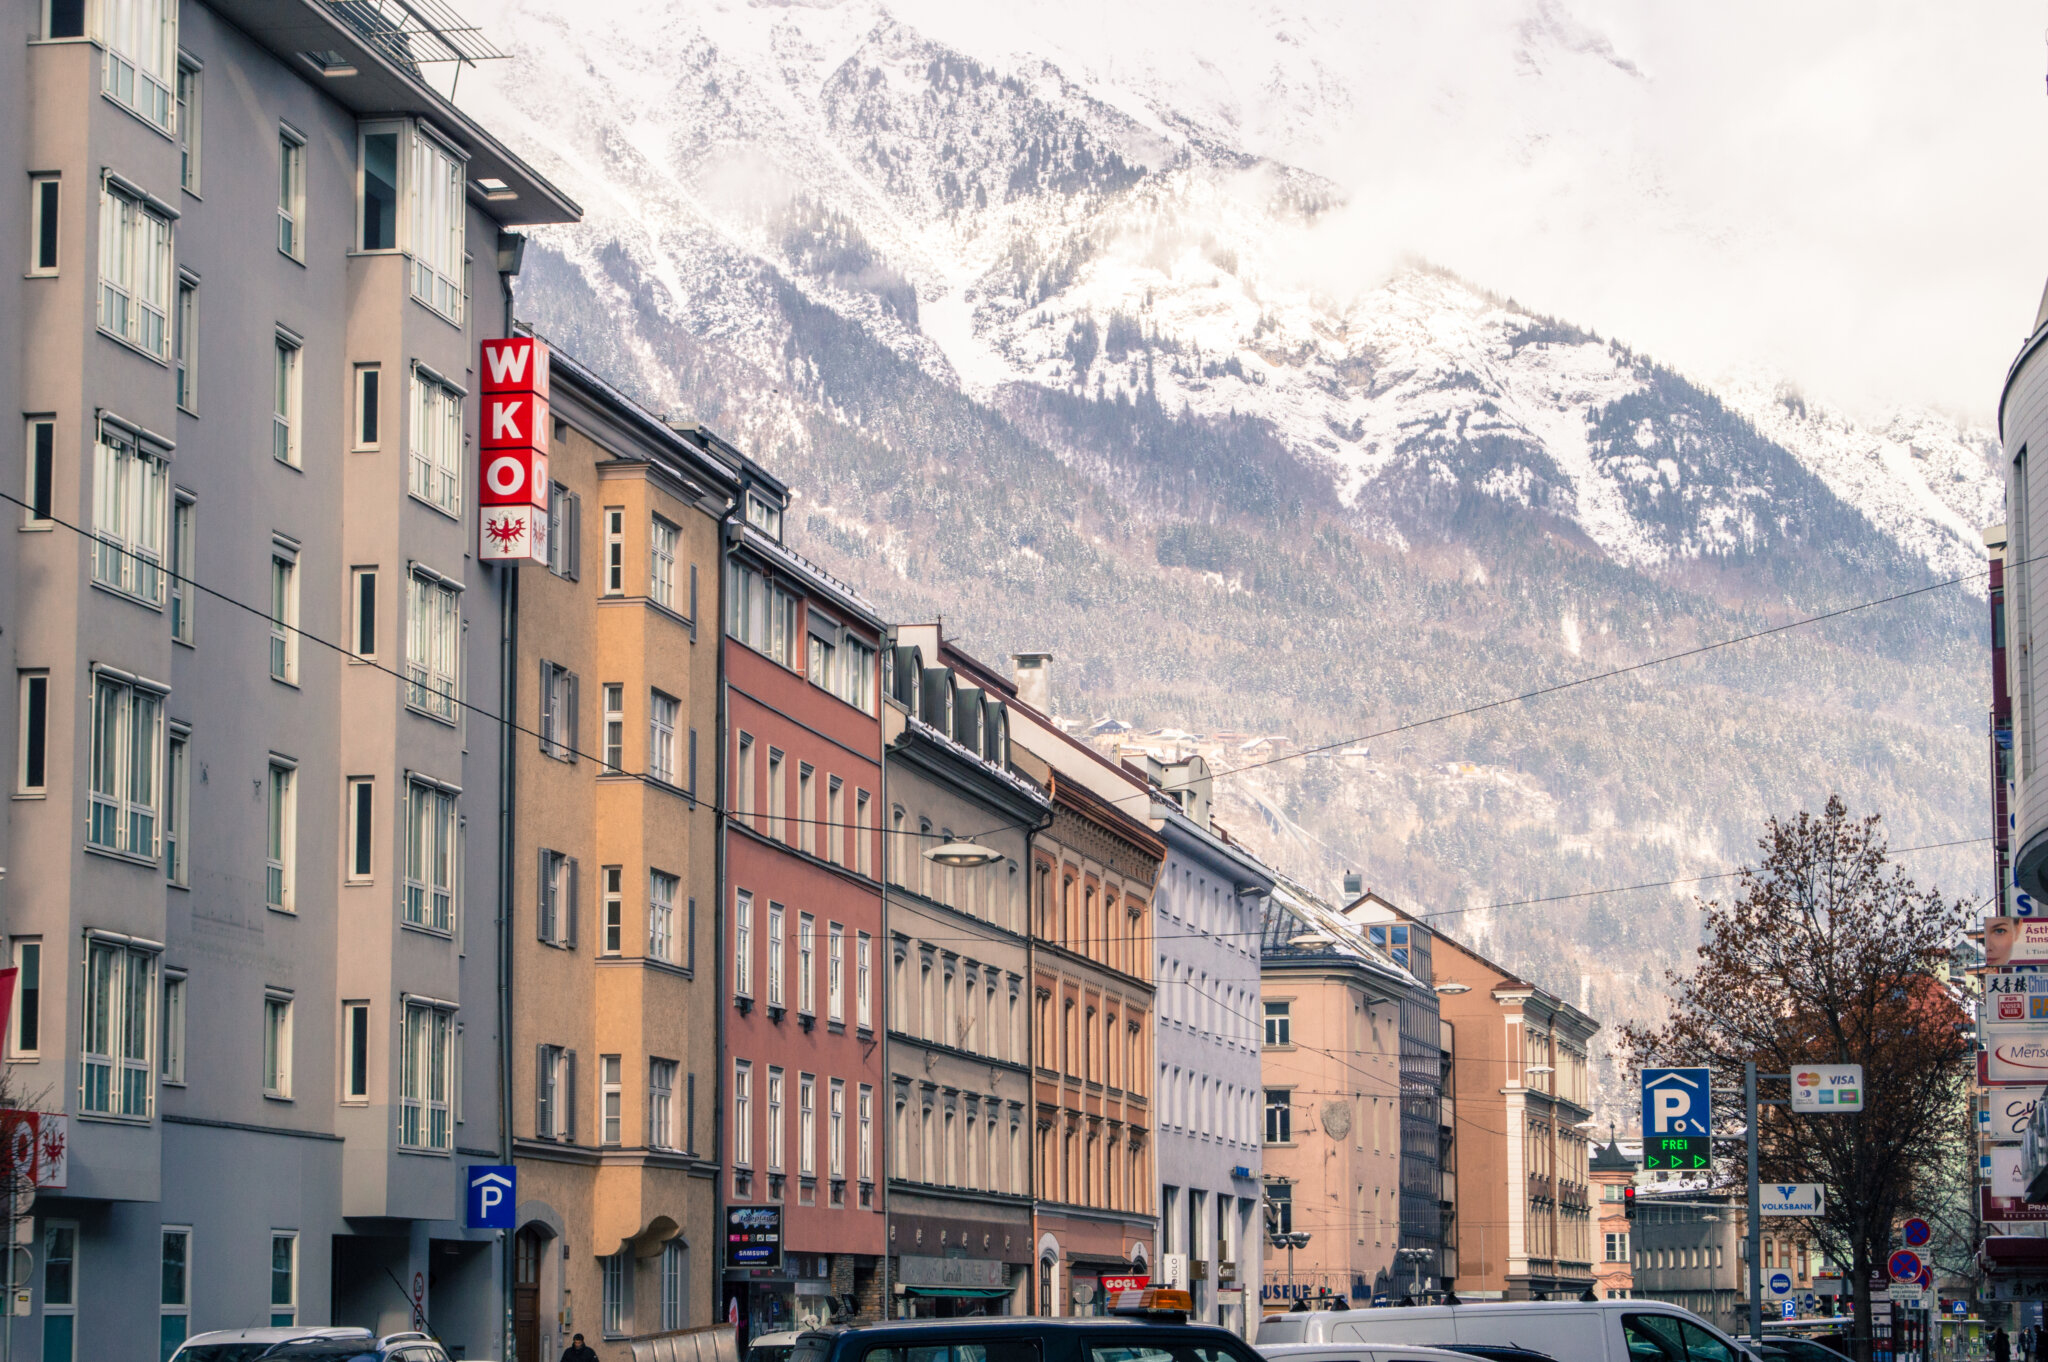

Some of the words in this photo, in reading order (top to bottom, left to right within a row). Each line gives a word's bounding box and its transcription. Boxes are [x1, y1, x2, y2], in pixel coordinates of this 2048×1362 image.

[485, 345, 531, 496] WKO
[1829, 1075, 1855, 1085] VISA
[1653, 1089, 1691, 1133] P
[1662, 1139, 1688, 1150] FREI
[481, 1186, 503, 1219] P
[1761, 1203, 1813, 1211] VOLKSBANK
[1105, 1279, 1138, 1289] GOGL
[1263, 1284, 1311, 1300] USEU
